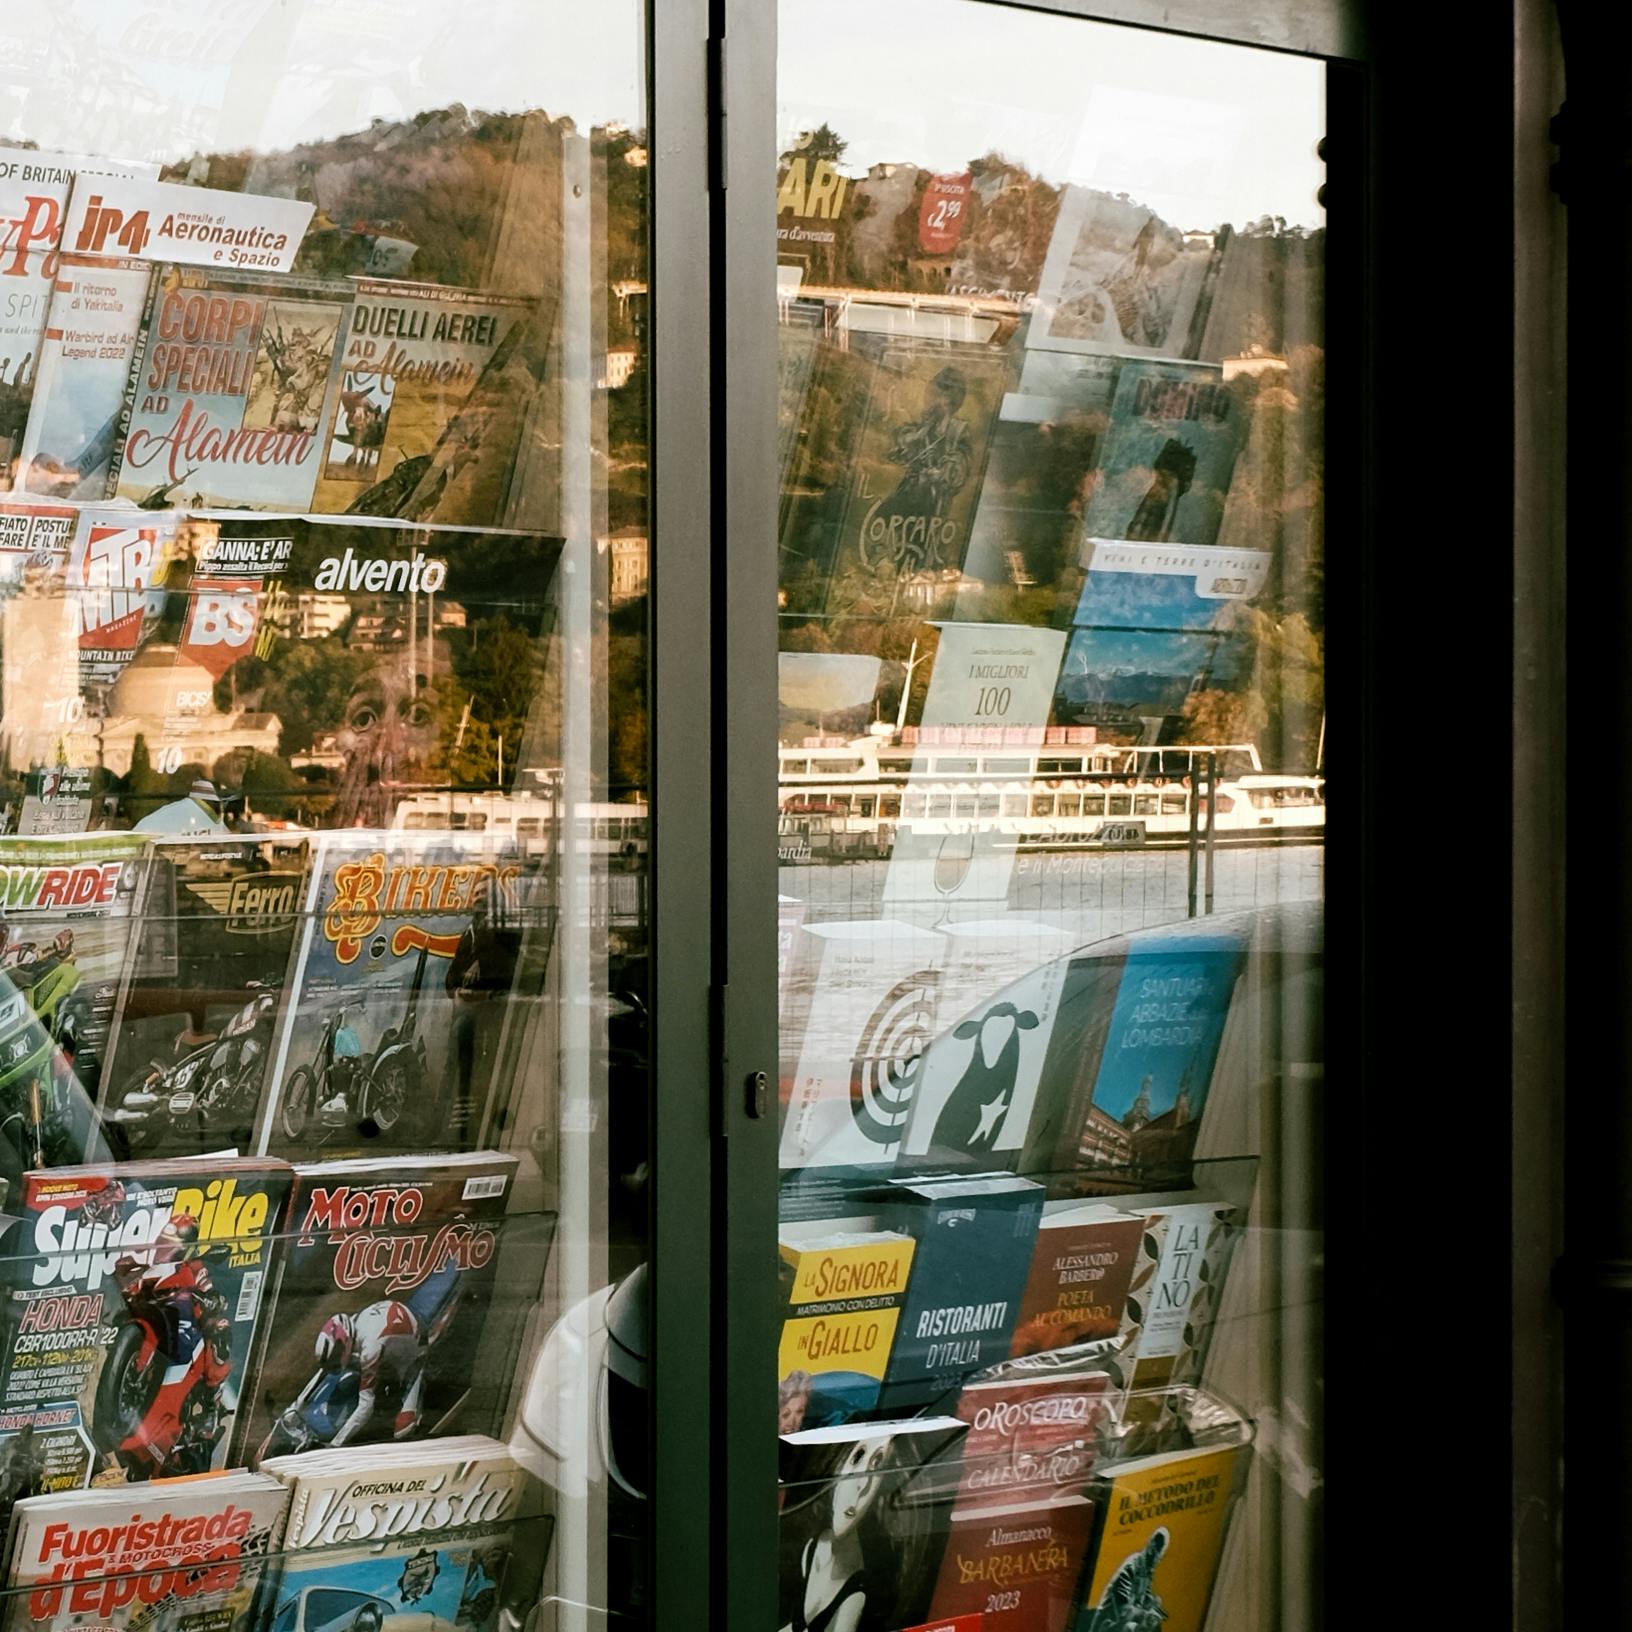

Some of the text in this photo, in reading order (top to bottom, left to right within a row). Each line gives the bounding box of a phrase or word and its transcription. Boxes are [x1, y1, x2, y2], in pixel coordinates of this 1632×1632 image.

[156, 213, 289, 251] Aeronautica
[227, 246, 282, 269] Spazio
[156, 291, 264, 348] CORPI
[351, 304, 499, 348] DUELLI AEREI
[147, 342, 253, 398] SPECIALI
[140, 394, 170, 416] AD
[124, 397, 316, 484] Alamein
[313, 546, 449, 594] alvento
[187, 594, 259, 648] BS
[974, 663, 1030, 681] MIGLIORI
[973, 685, 1013, 718] 100
[230, 876, 298, 922] Ferro
[30, 1177, 270, 1291] SuperBike
[296, 1186, 424, 1249] MOTO
[228, 1252, 262, 1270] ITALIA
[332, 1222, 497, 1296] CICLISMO
[814, 1256, 902, 1299] SIGNORA
[1051, 1250, 1120, 1273] ALESSANDRO
[17, 1293, 106, 1335] HONDA
[795, 1298, 842, 1316] MATRIMONIO
[915, 1300, 1009, 1340] RISTORANTI
[806, 1320, 881, 1362] GIALLO
[924, 1337, 982, 1370] D'ITALIA
[973, 1395, 1090, 1437] OROSCOPO
[352, 1479, 404, 1499] OFFICINA
[966, 1453, 1083, 1492] CALENDARIO
[288, 1471, 514, 1554] Vespista
[1117, 1488, 1219, 1528] COCCODRILLO
[37, 1503, 255, 1566] Fuoristrada
[984, 1525, 1054, 1549] Almanacco
[27, 1542, 244, 1622] d'Epoca
[956, 1545, 1071, 1587] BARBANERA
[982, 1590, 1022, 1616] 2023
